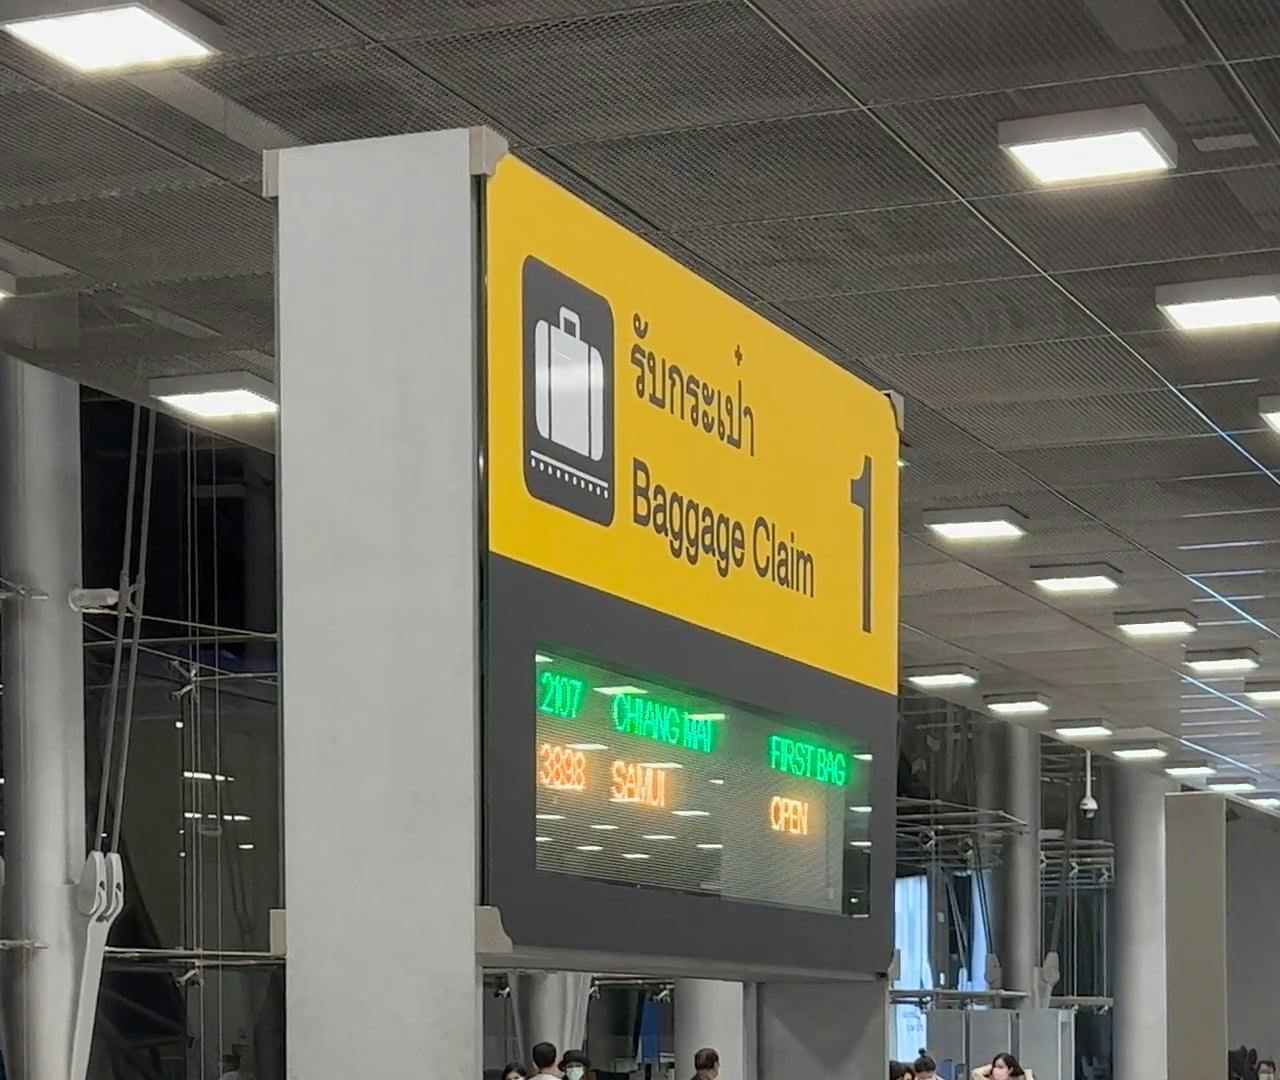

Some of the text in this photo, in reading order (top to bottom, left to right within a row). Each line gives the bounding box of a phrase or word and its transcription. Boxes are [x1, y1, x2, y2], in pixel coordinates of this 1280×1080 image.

[630, 312, 755, 457] รับกระเป๋า
[632, 456, 815, 598] Baggage Claim
[850, 454, 872, 635] 1
[610, 761, 667, 807] SAMUI
[770, 795, 809, 835] OPEN
[612, 693, 681, 745] CHIANG
[682, 711, 713, 752] MAI
[769, 734, 815, 777] FIRST
[816, 748, 846, 786] BAG
